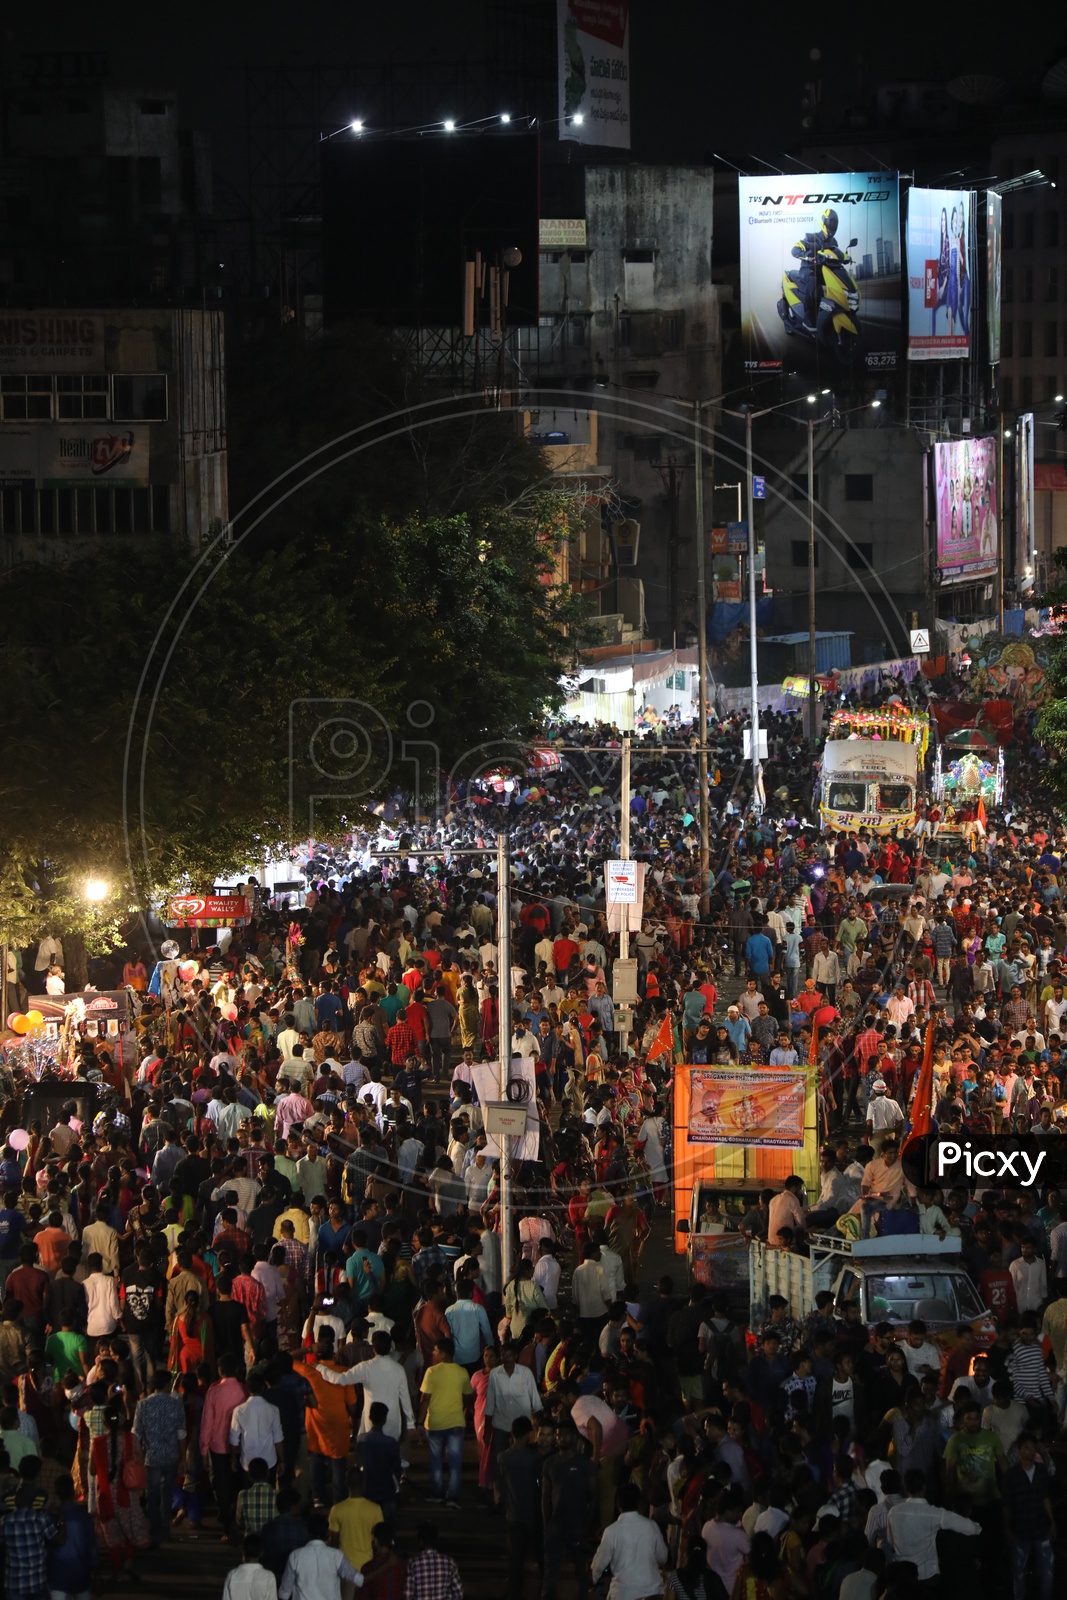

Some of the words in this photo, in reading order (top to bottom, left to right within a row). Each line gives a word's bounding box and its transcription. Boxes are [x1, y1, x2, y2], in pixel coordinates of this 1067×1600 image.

[762, 192, 864, 206] NTORQ
[864, 192, 889, 201] 125
[540, 220, 584, 229] NANDA
[0, 319, 94, 344] NISHING
[42, 347, 93, 356] CARPETS
[60, 438, 93, 460] Realty
[714, 534, 726, 543] W
[860, 816, 882, 826] राधे
[992, 1288, 1007, 1305] 23
[832, 1390, 851, 1400] NIKE
